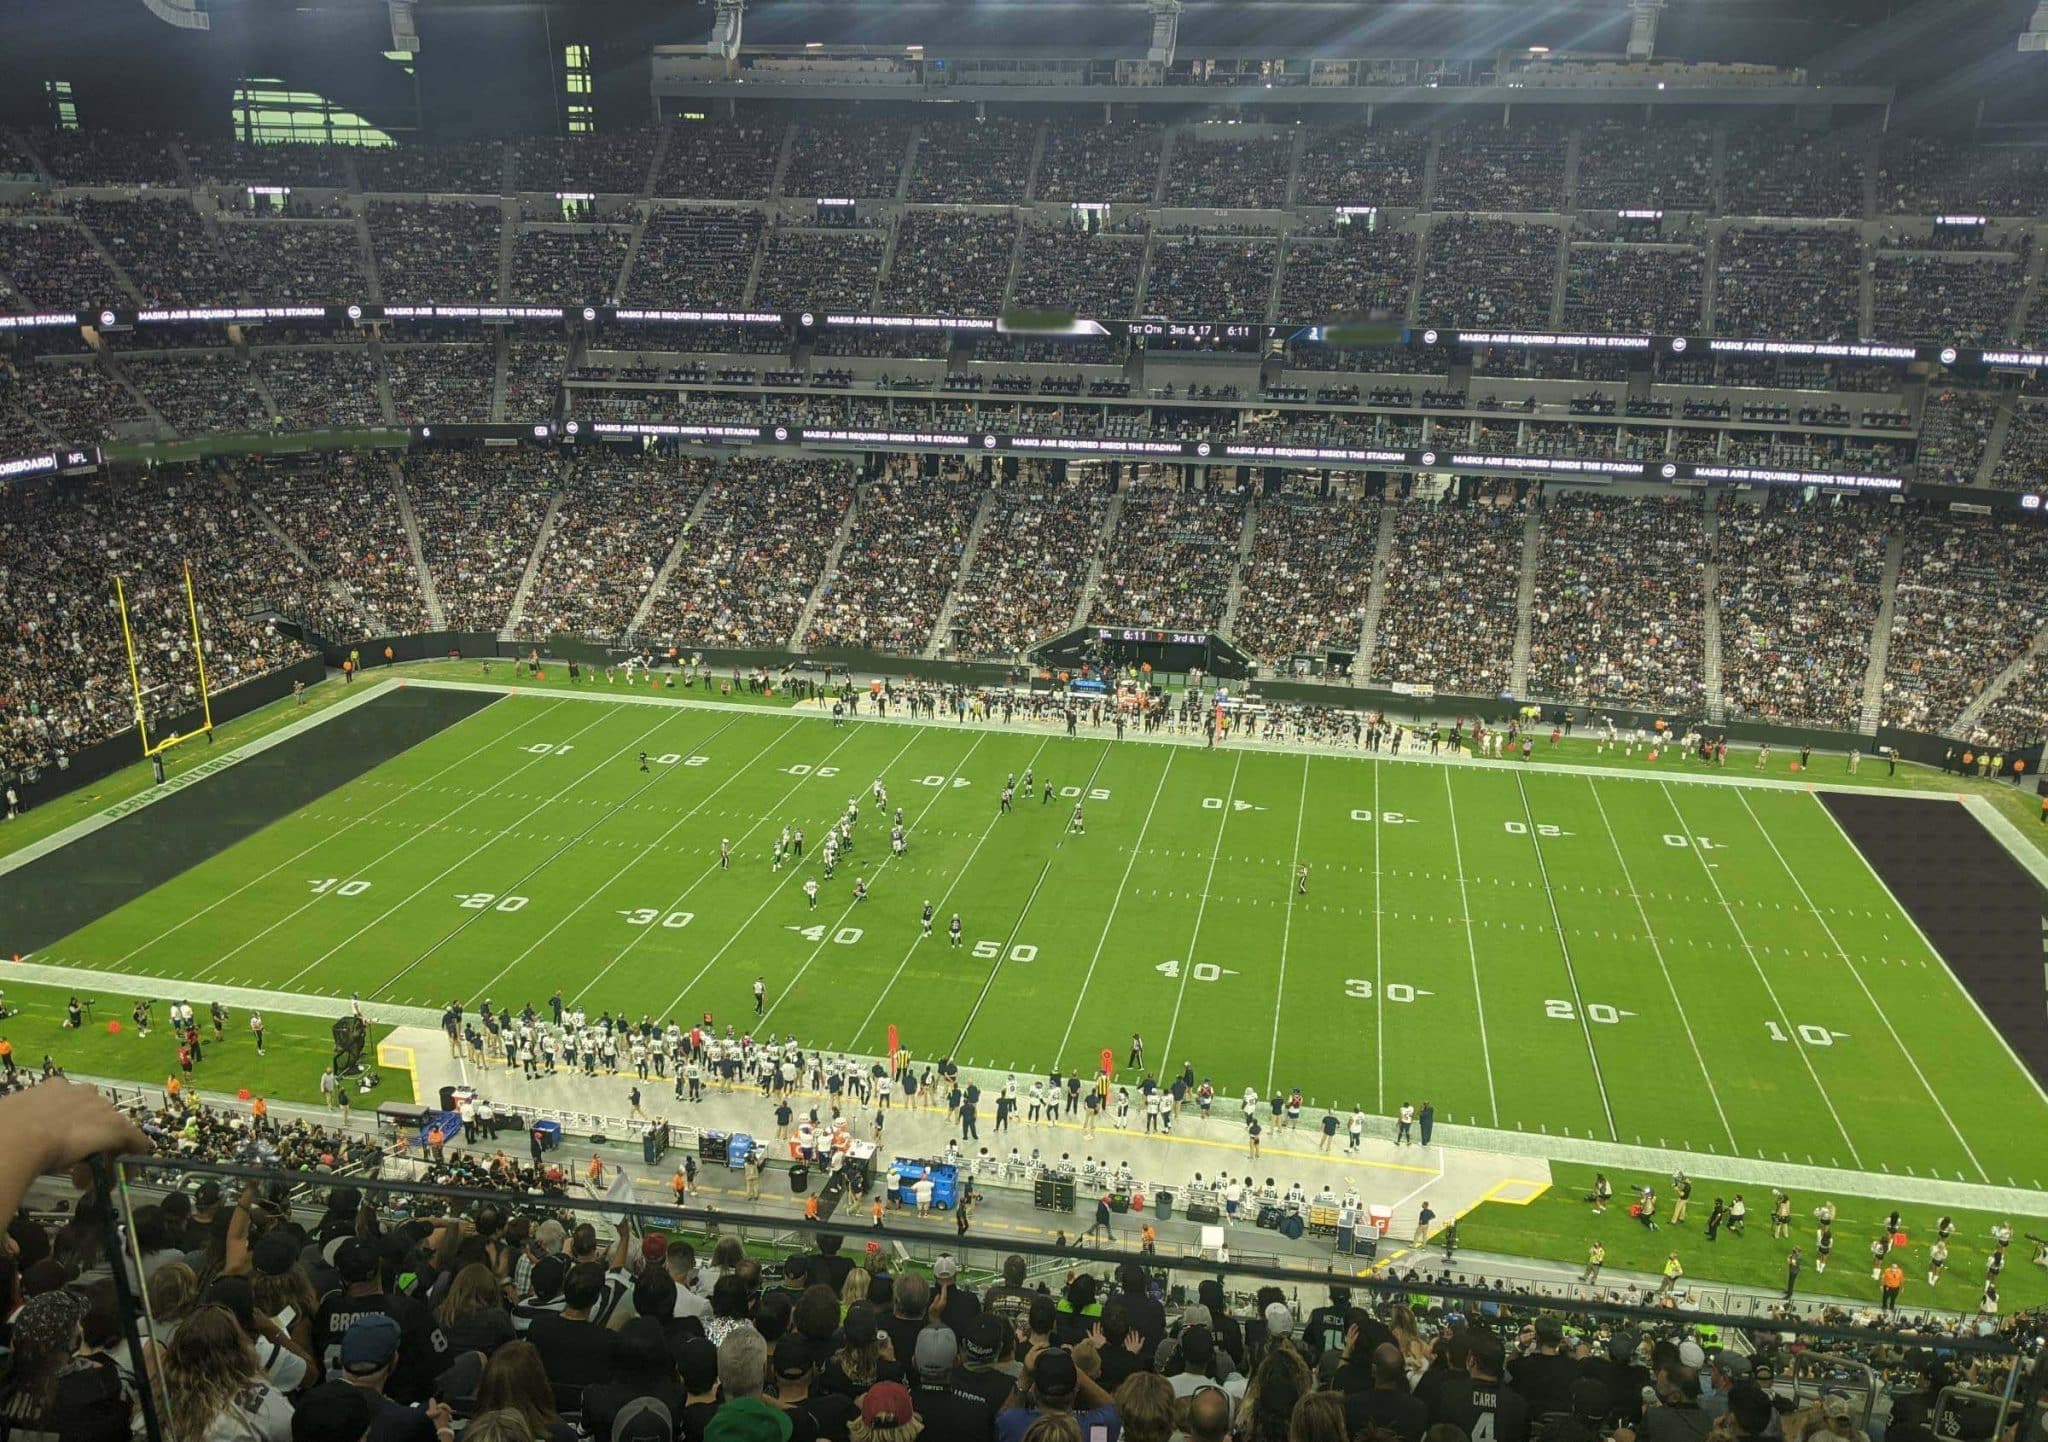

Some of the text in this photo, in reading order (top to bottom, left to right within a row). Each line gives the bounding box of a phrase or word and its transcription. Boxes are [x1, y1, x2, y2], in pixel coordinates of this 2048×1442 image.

[139, 312, 168, 321] MASKS
[170, 311, 188, 319] ARE
[189, 310, 234, 318] REQUIRED
[237, 309, 265, 317] INSIDE
[285, 308, 325, 317] STADIUM
[384, 308, 413, 316] MASKS
[526, 309, 562, 317] STADIUM
[616, 311, 642, 319] MASKS
[645, 311, 660, 319] ARE
[662, 312, 701, 320] REQUIRED
[746, 314, 780, 322] STADIUM
[17, 316, 34, 325] THE
[36, 315, 76, 325] STADIUM
[827, 316, 854, 325] MASKS
[941, 319, 955, 327] THE
[958, 320, 993, 328] STADIUM
[1188, 325, 1196, 335] &
[1199, 325, 1211, 335] 17
[1227, 326, 1250, 336] 6:11
[1268, 327, 1276, 337] 7
[1459, 334, 1489, 343] MASKS
[1491, 335, 1509, 343] ARE
[1511, 335, 1555, 344] REQUIRED
[1589, 337, 1606, 345] THE
[1608, 338, 1648, 347] STADIUM
[1711, 341, 1915, 358] MASKS ARE REQUIRED INSIDE THE STADIUM
[1983, 353, 2042, 365] MASKS ARE
[594, 424, 621, 432] MASKS
[708, 427, 723, 435] THE
[724, 428, 760, 436] STADIUM
[803, 431, 829, 439] MASKS
[933, 436, 968, 444] STADIUM
[1012, 439, 1039, 447] MASKS
[1059, 440, 1098, 448] REQUIRED
[1145, 444, 1181, 452] STADIUM
[68, 452, 87, 464] NFL
[1227, 447, 1255, 455] MASKS
[1275, 448, 1317, 457] REQUIRED
[1319, 450, 1346, 458] INSIDE
[1348, 451, 1365, 459] THE
[1366, 452, 1405, 461] STADIUM
[0, 456, 53, 475] OREBOARD
[1453, 456, 1483, 465] MASKS
[1504, 459, 1549, 467] REQUIRED
[1551, 461, 1581, 469] INSIDE
[1583, 462, 1600, 470] THE
[1602, 463, 1643, 473] STADIUM
[1695, 468, 1901, 488] MASKS ARE REQUIRED INSIDE THE STADIUM
[1123, 630, 1146, 640] 6:11
[1173, 634, 1206, 643] 3rd & 17
[103, 754, 244, 818] PLAY FOOTBALL
[310, 878, 372, 896] 10
[460, 893, 529, 912] 20
[627, 908, 694, 928] 30
[799, 925, 863, 944] 40
[972, 940, 1038, 962] 50
[1156, 960, 1220, 981] 40
[1345, 979, 1415, 1003] 30
[1545, 999, 1618, 1024] 20
[1764, 1020, 1833, 1046] 10
[1263, 1190, 1274, 1199] 90
[1376, 1219, 1385, 1228] G
[330, 1312, 385, 1332] BRO
[430, 1328, 448, 1353] 8
[1473, 1391, 1497, 1409] CARR
[1470, 1411, 1495, 1442] 4
